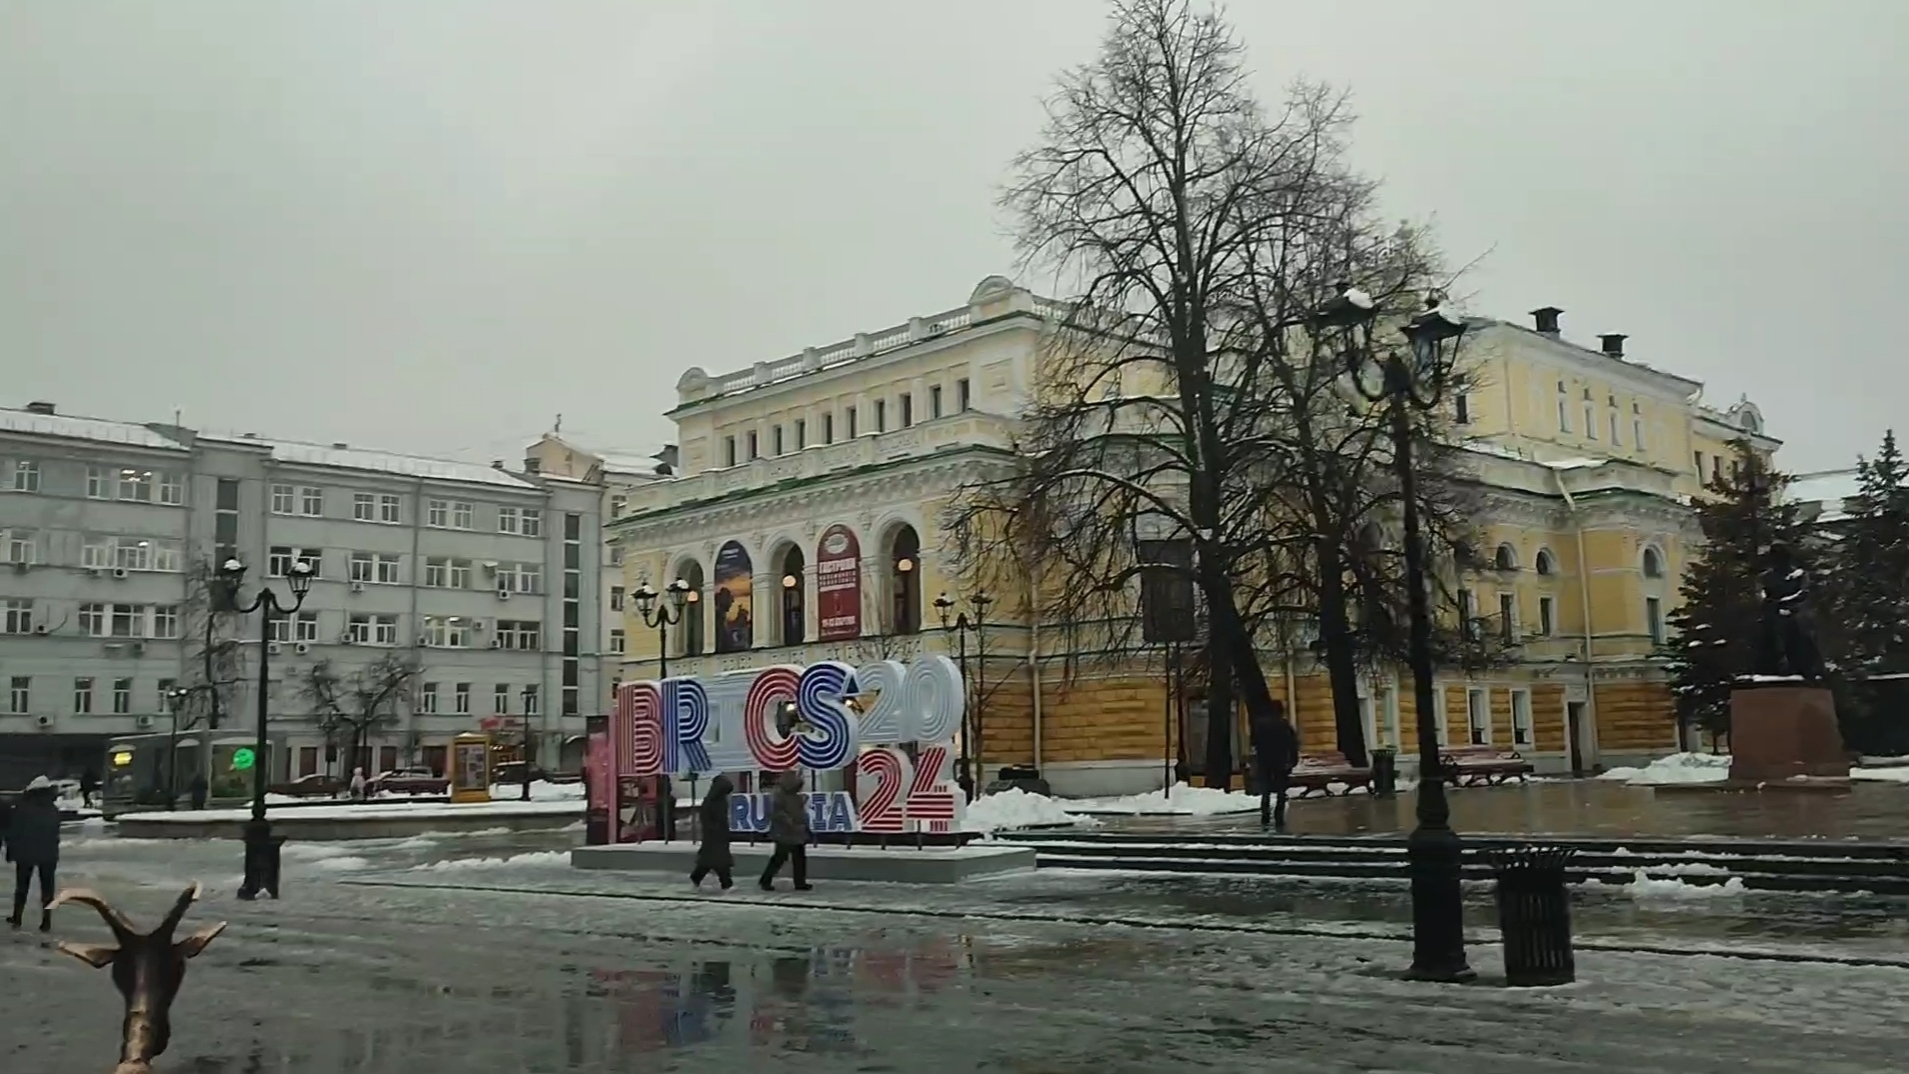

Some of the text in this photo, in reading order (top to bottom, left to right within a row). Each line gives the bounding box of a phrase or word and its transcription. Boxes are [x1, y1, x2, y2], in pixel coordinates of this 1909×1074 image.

[617, 656, 964, 776] BRICS 20
[730, 746, 955, 833] RUIA 24
